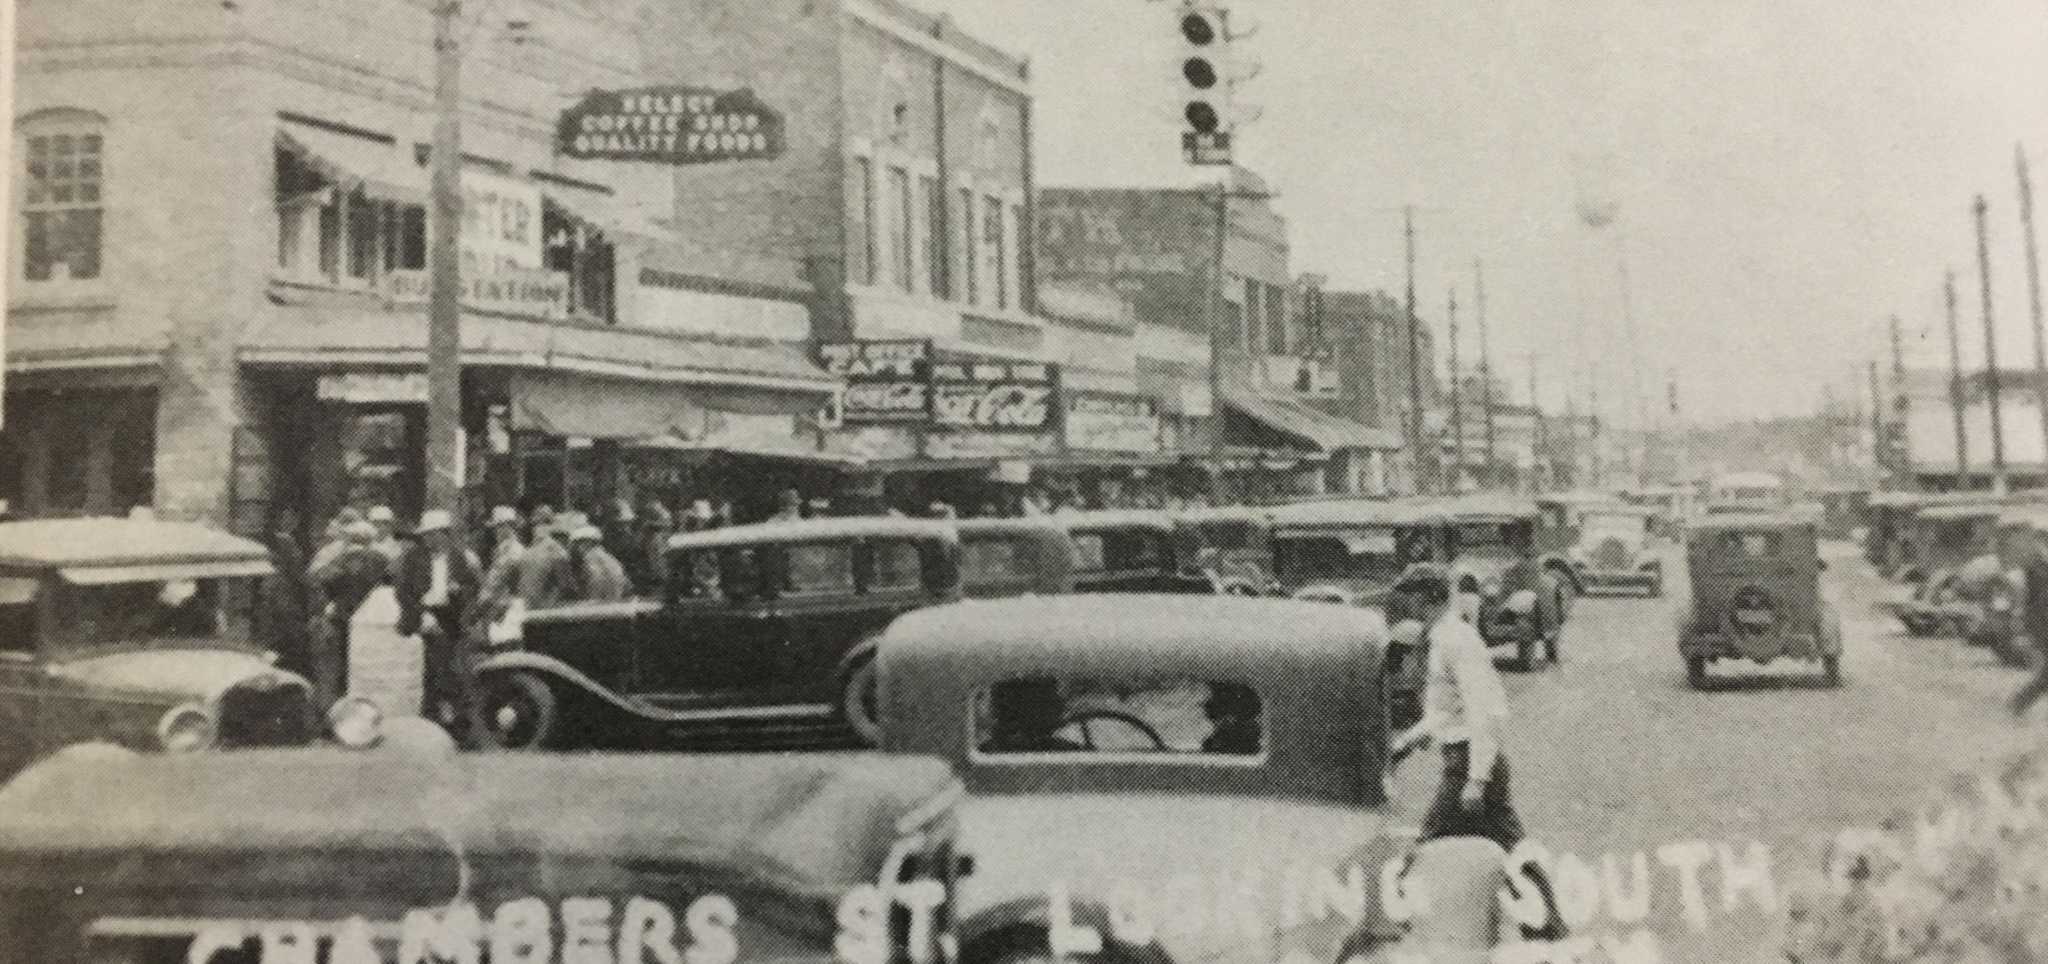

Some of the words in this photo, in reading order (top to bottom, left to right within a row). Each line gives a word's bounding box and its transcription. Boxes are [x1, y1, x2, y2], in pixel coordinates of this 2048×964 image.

[621, 96, 715, 114] SELECT
[582, 114, 679, 133] COFFEE
[694, 114, 760, 133] SHOP
[575, 134, 677, 152] QUALITY
[686, 132, 767, 152] FOODS
